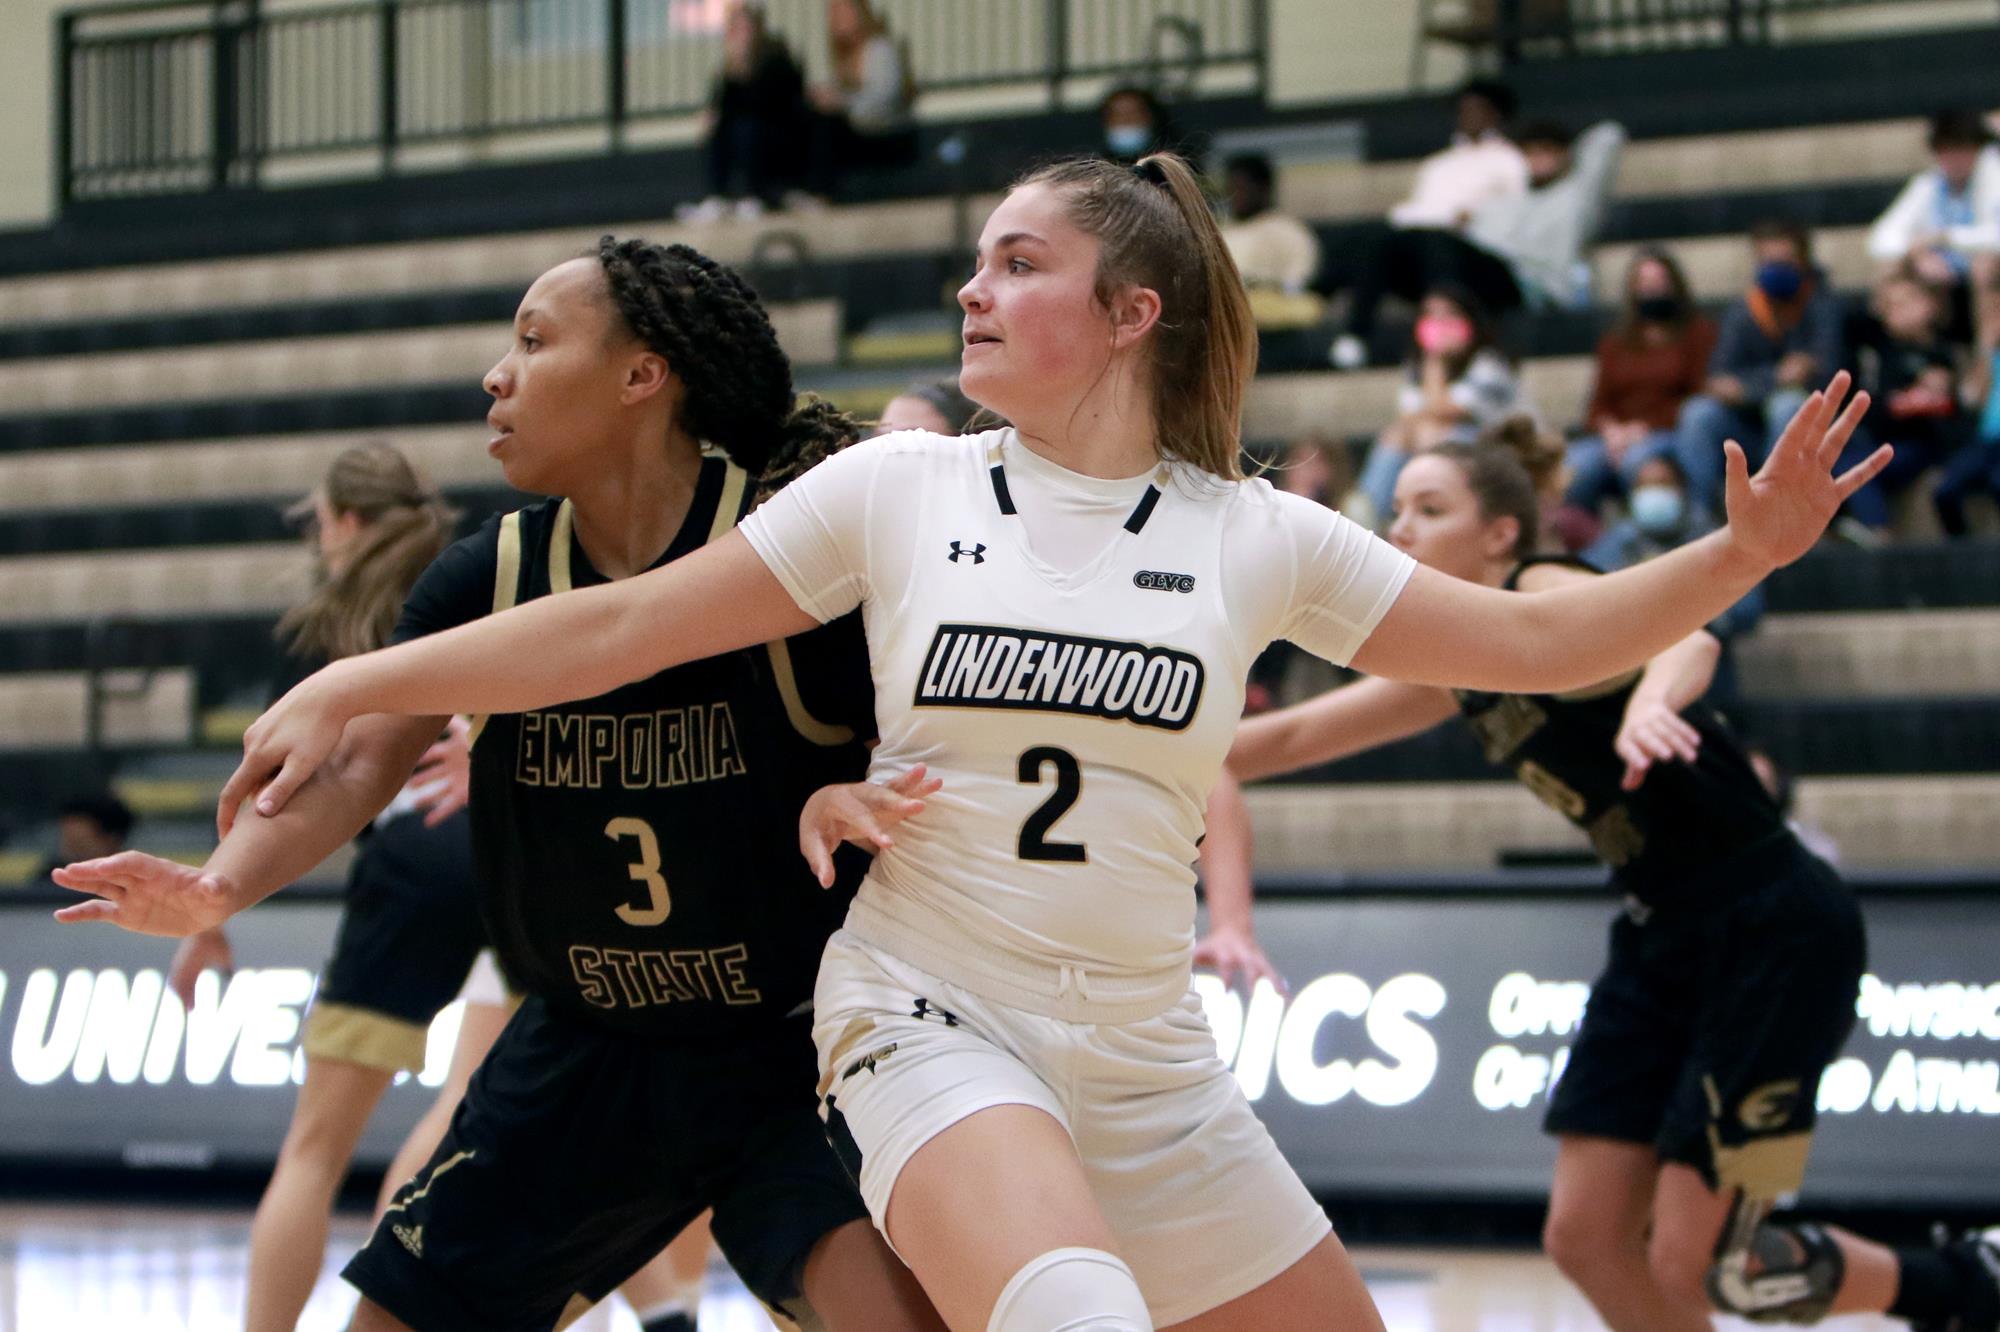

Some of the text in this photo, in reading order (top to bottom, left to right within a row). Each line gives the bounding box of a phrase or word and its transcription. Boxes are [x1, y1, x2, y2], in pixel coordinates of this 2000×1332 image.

[1133, 570, 1195, 593] GLVC
[921, 632, 1198, 722] LINDENWOOD
[516, 701, 747, 789] EMPORIA
[1017, 745, 1088, 863] 2
[604, 816, 671, 927] 3
[569, 943, 762, 1009] STATE
[11, 967, 312, 1085] UNIVE
